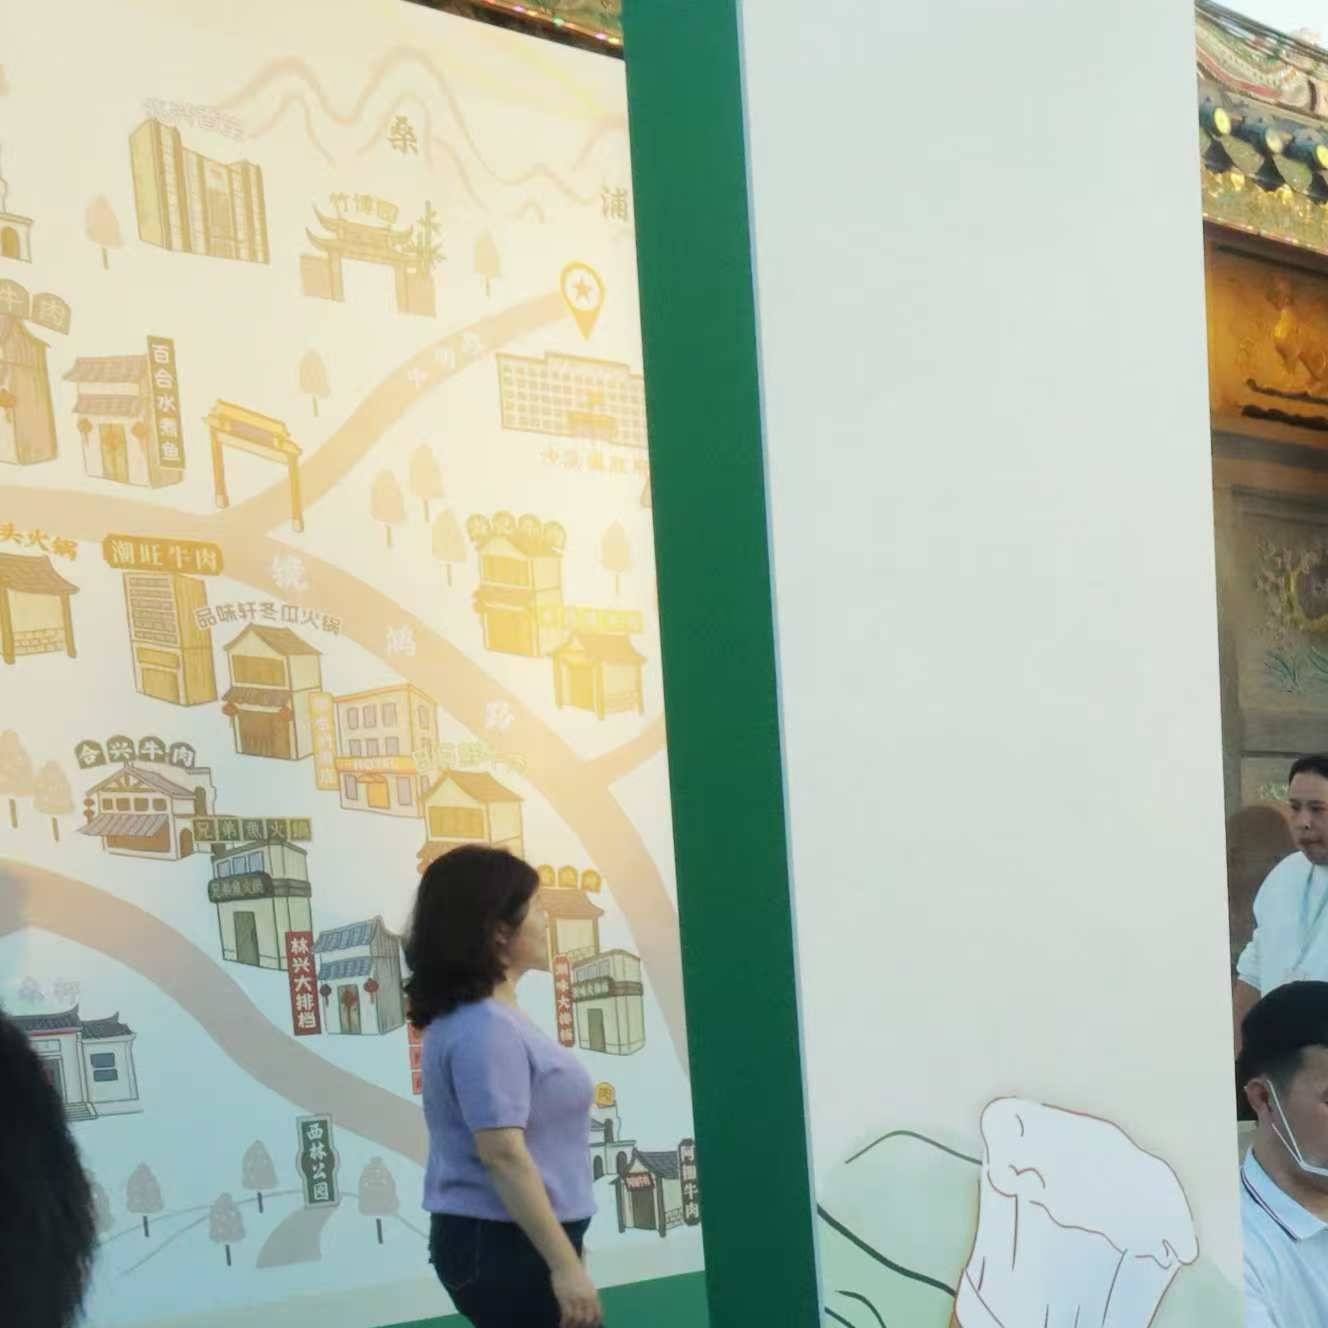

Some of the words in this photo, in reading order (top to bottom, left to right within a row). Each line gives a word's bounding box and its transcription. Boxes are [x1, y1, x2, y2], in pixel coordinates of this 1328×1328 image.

[290, 937, 316, 1029] 林兴大排档
[307, 1122, 329, 1200] 西林公园
